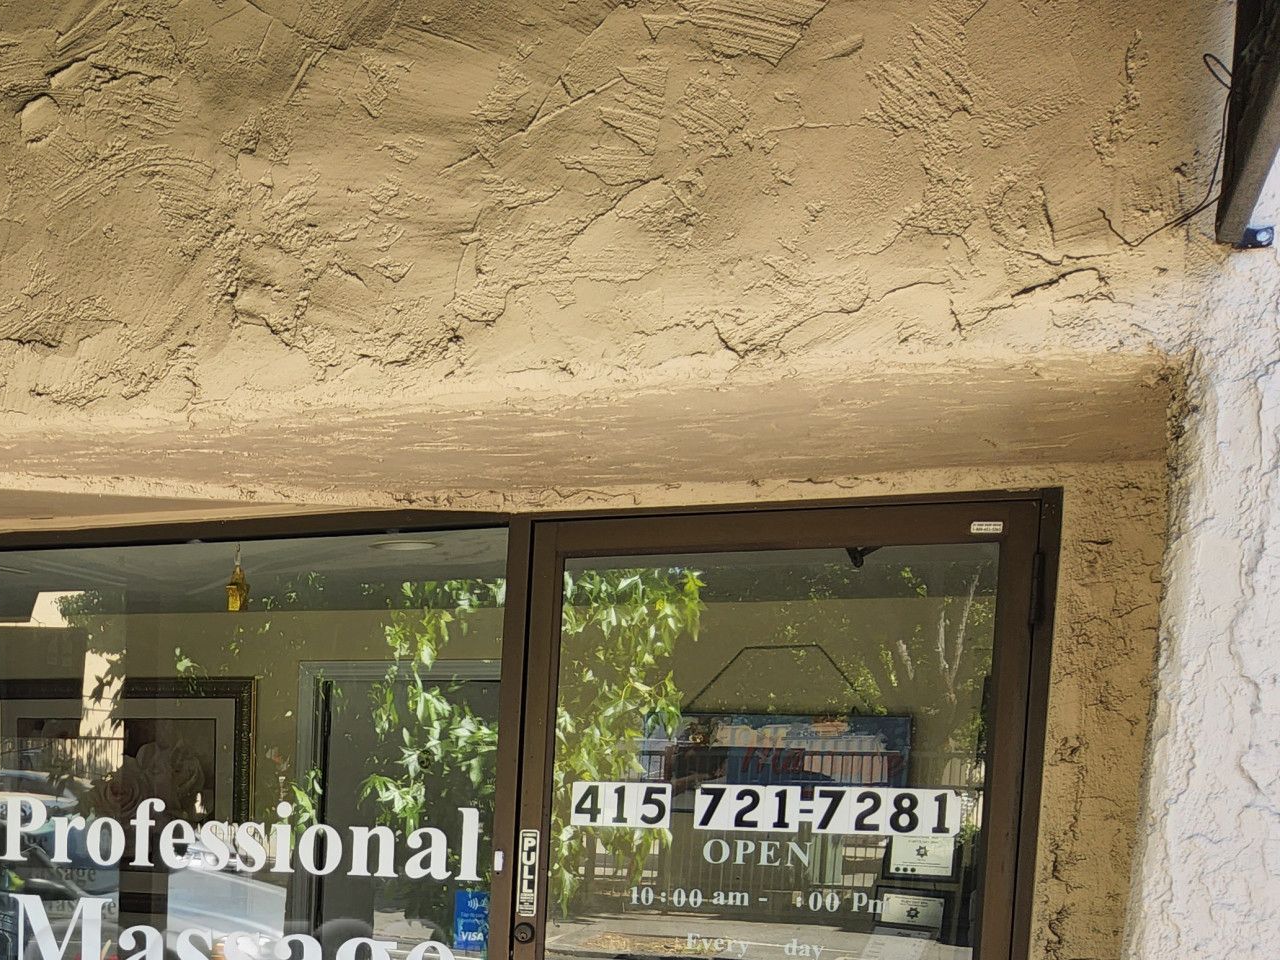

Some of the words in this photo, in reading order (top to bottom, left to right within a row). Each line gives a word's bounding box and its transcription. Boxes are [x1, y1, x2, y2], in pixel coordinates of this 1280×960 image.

[574, 784, 668, 824] 415
[697, 787, 951, 835] 721-7281
[0, 795, 482, 882] Professional
[703, 838, 813, 868] OPEN
[521, 837, 537, 893] PULL
[712, 890, 750, 906] am
[460, 931, 484, 941] VISA
[687, 932, 749, 958] Every
